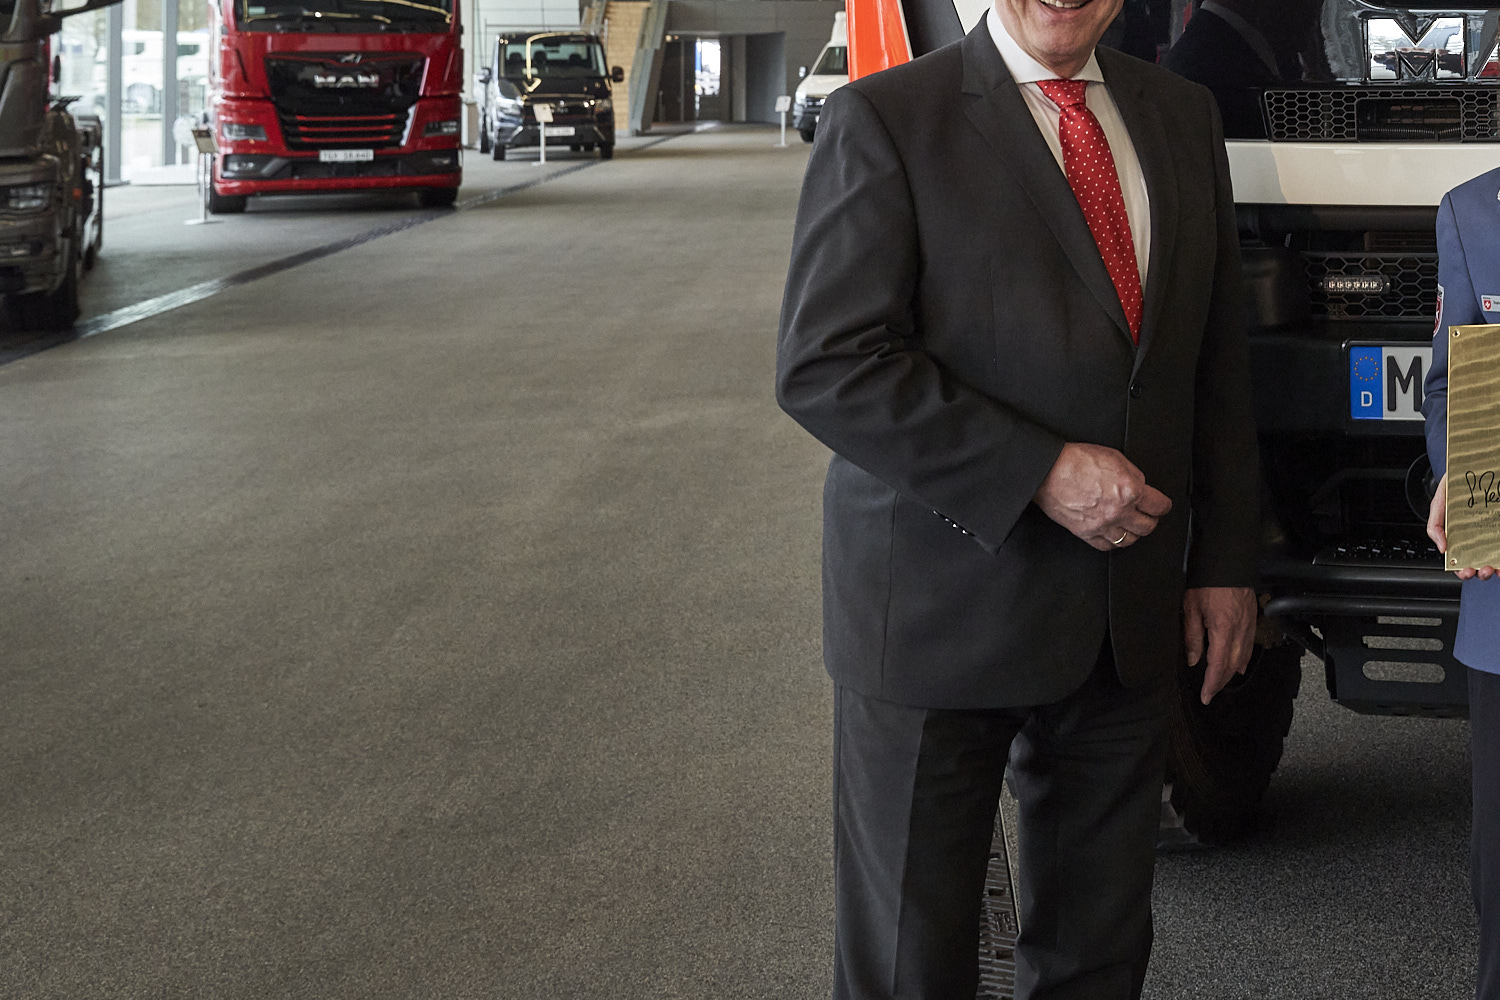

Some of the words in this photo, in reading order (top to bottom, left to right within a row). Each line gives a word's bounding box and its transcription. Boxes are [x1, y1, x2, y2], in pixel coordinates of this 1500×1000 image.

[314, 74, 379, 88] MAN
[1361, 391, 1373, 407] D
[1387, 355, 1422, 412] M
